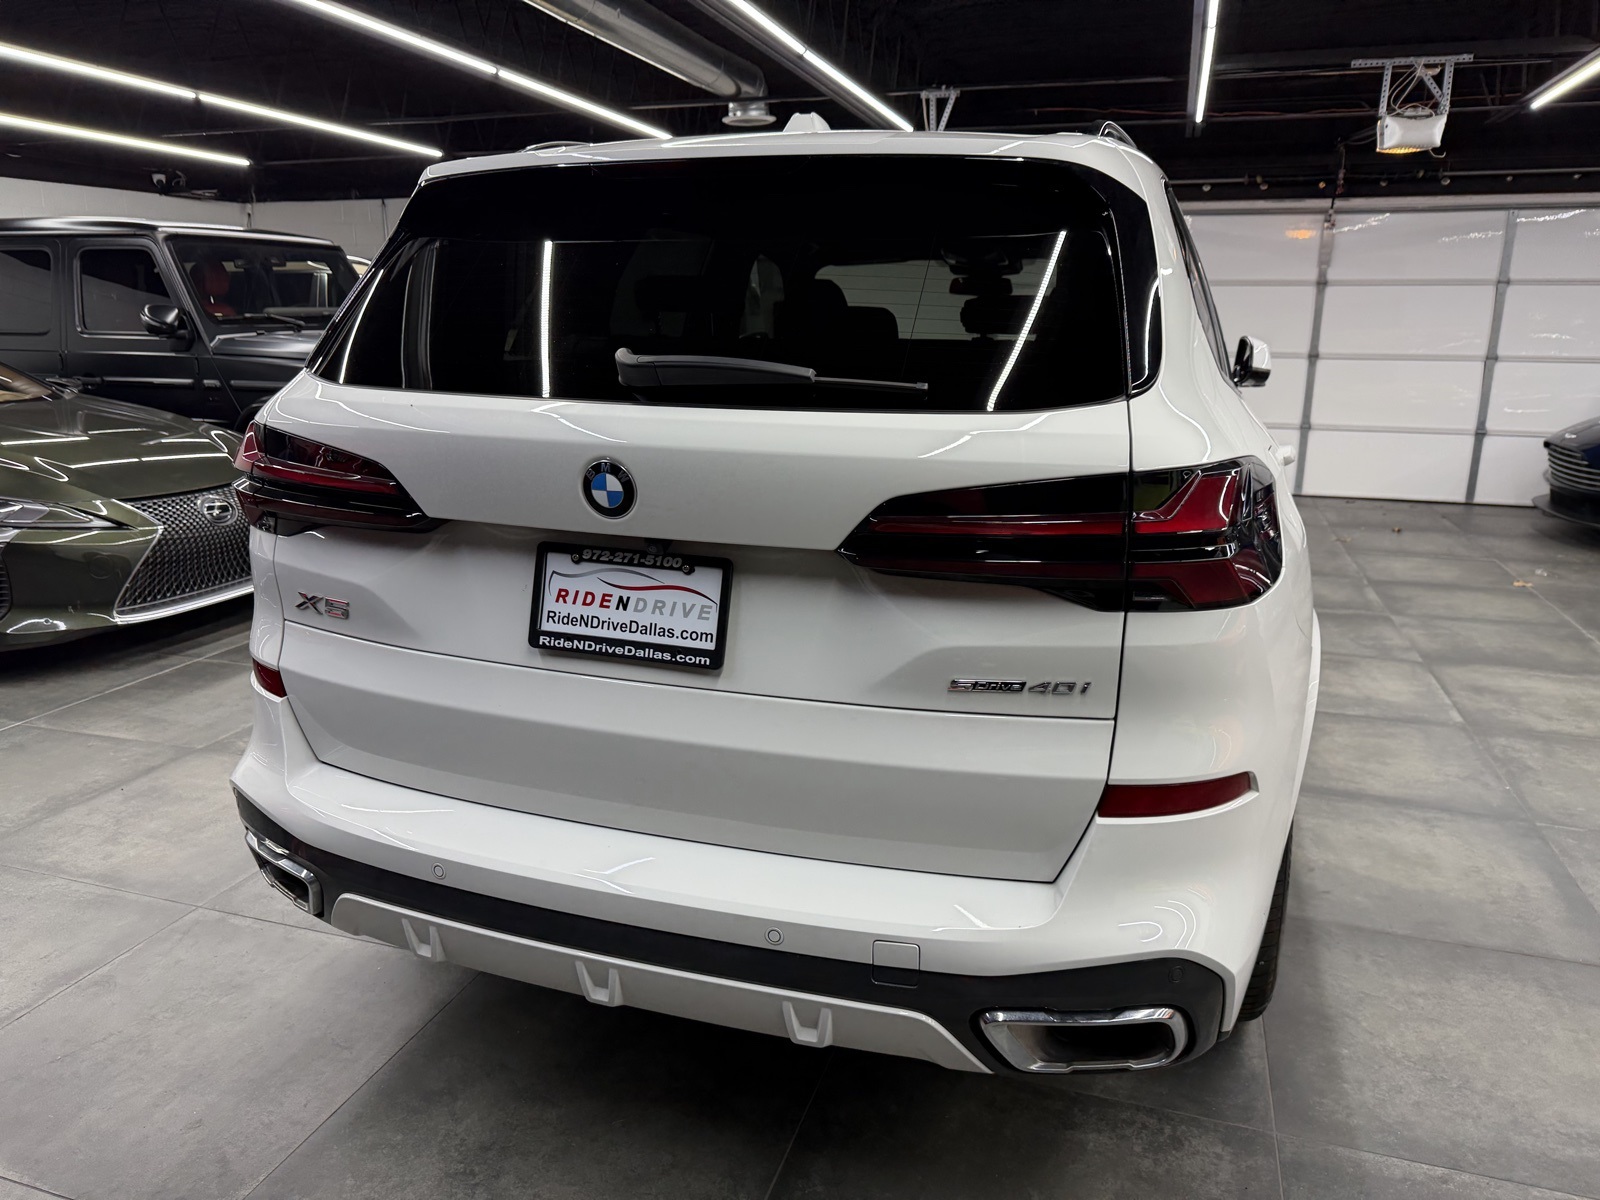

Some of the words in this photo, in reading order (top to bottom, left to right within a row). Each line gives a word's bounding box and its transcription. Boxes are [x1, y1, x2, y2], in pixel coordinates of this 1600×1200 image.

[585, 462, 629, 482] BMW
[582, 549, 682, 568] 972-271-5100
[295, 591, 349, 619] X5
[555, 588, 712, 621] RIDENDRIVE
[546, 610, 714, 643] RideNDriveDallas.com
[539, 635, 710, 666] RideNDriveDallas.com
